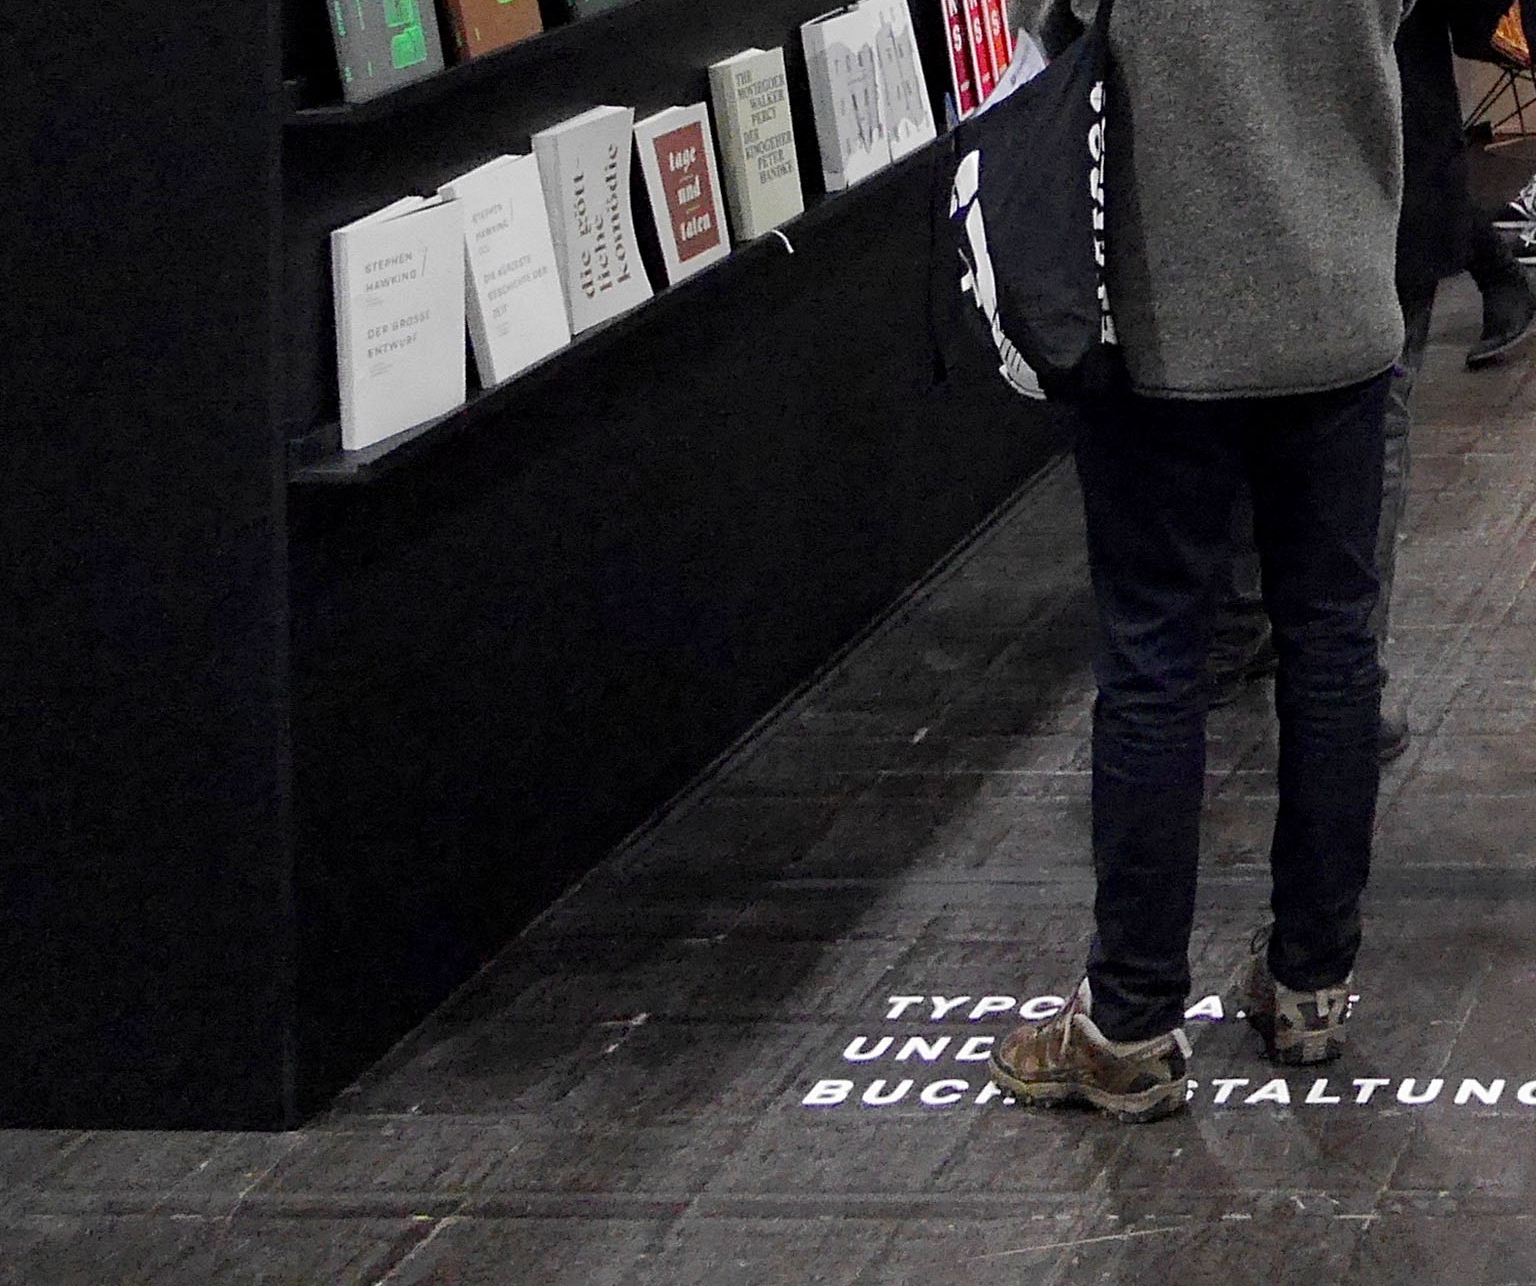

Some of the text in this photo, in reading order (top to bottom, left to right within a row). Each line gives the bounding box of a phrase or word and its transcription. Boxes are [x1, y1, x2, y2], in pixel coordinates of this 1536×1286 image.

[364, 250, 413, 275] STEPHEN
[366, 268, 417, 293] HAWKING
[367, 309, 431, 341] DER GROSSE
[367, 332, 417, 359] ENTWURF
